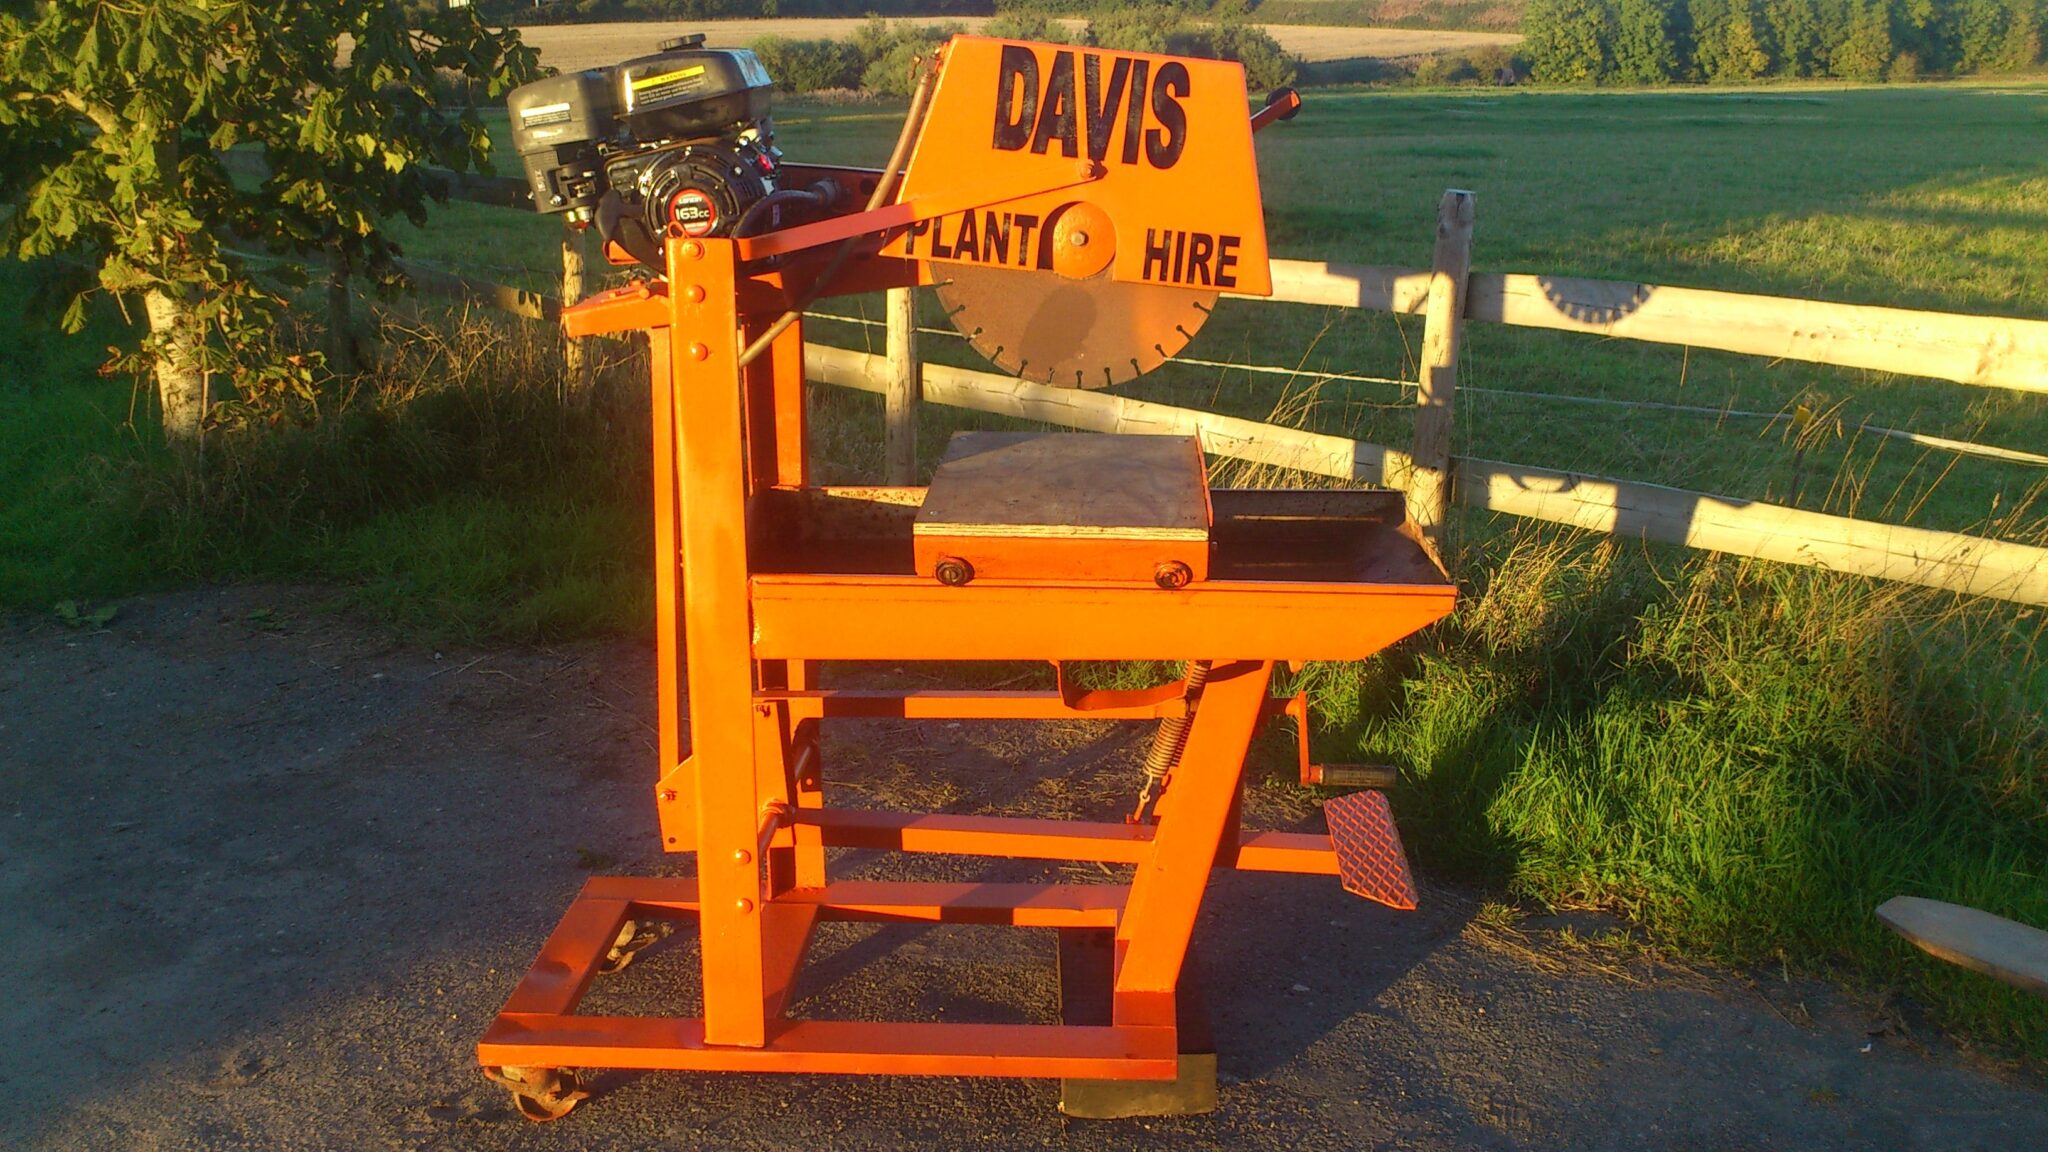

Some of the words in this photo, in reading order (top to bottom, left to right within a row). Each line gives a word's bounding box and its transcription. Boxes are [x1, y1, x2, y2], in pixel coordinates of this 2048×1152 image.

[991, 44, 1191, 169] DAVIS
[675, 206, 710, 220] 163cc
[905, 207, 1040, 267] PLANT
[1142, 228, 1241, 288] HIRE
